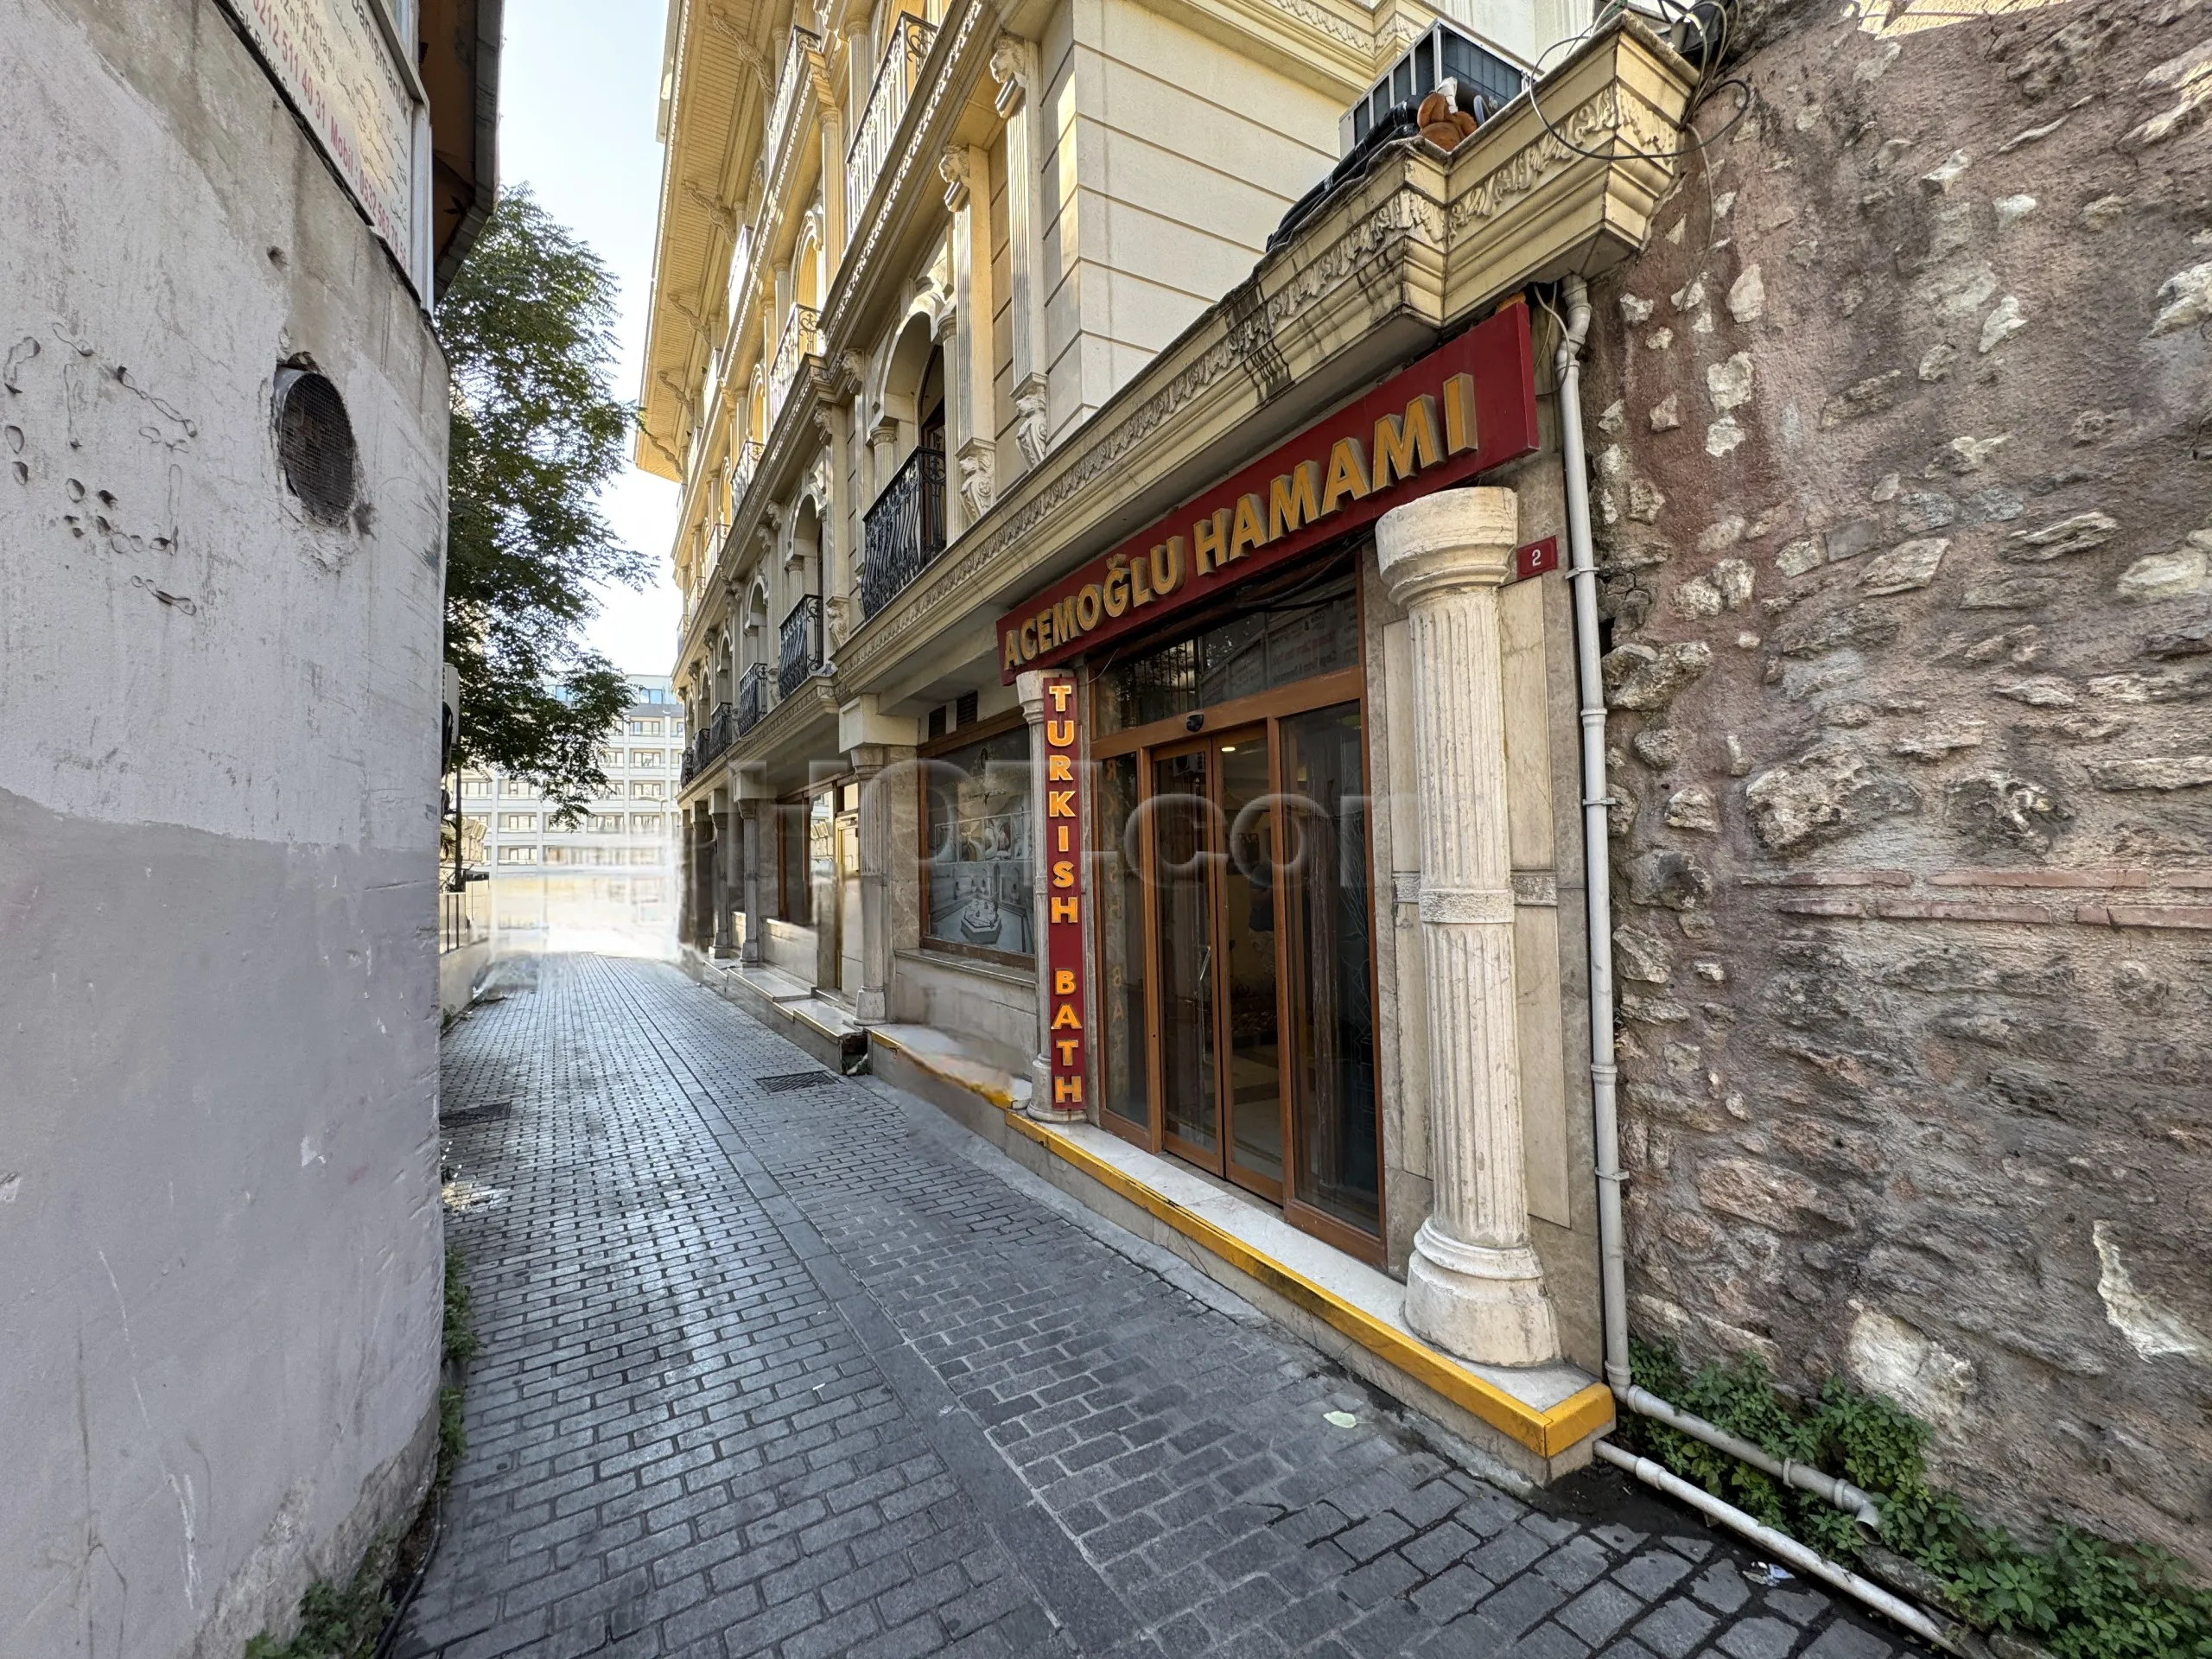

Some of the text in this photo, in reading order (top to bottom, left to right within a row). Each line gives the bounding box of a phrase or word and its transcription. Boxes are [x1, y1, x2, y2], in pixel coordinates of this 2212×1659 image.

[282, 29, 299, 83] 511
[302, 68, 313, 106] 40
[315, 89, 327, 130] 31
[330, 114, 353, 178] Mobil
[359, 168, 377, 218] 0532
[302, 26, 327, 84] Alma
[1003, 536, 1185, 671] ACEMOĞLU
[1193, 372, 1478, 576] HAMAMI
[1531, 549, 1541, 567] 2
[1046, 684, 1083, 1104] TURKISH BATH
